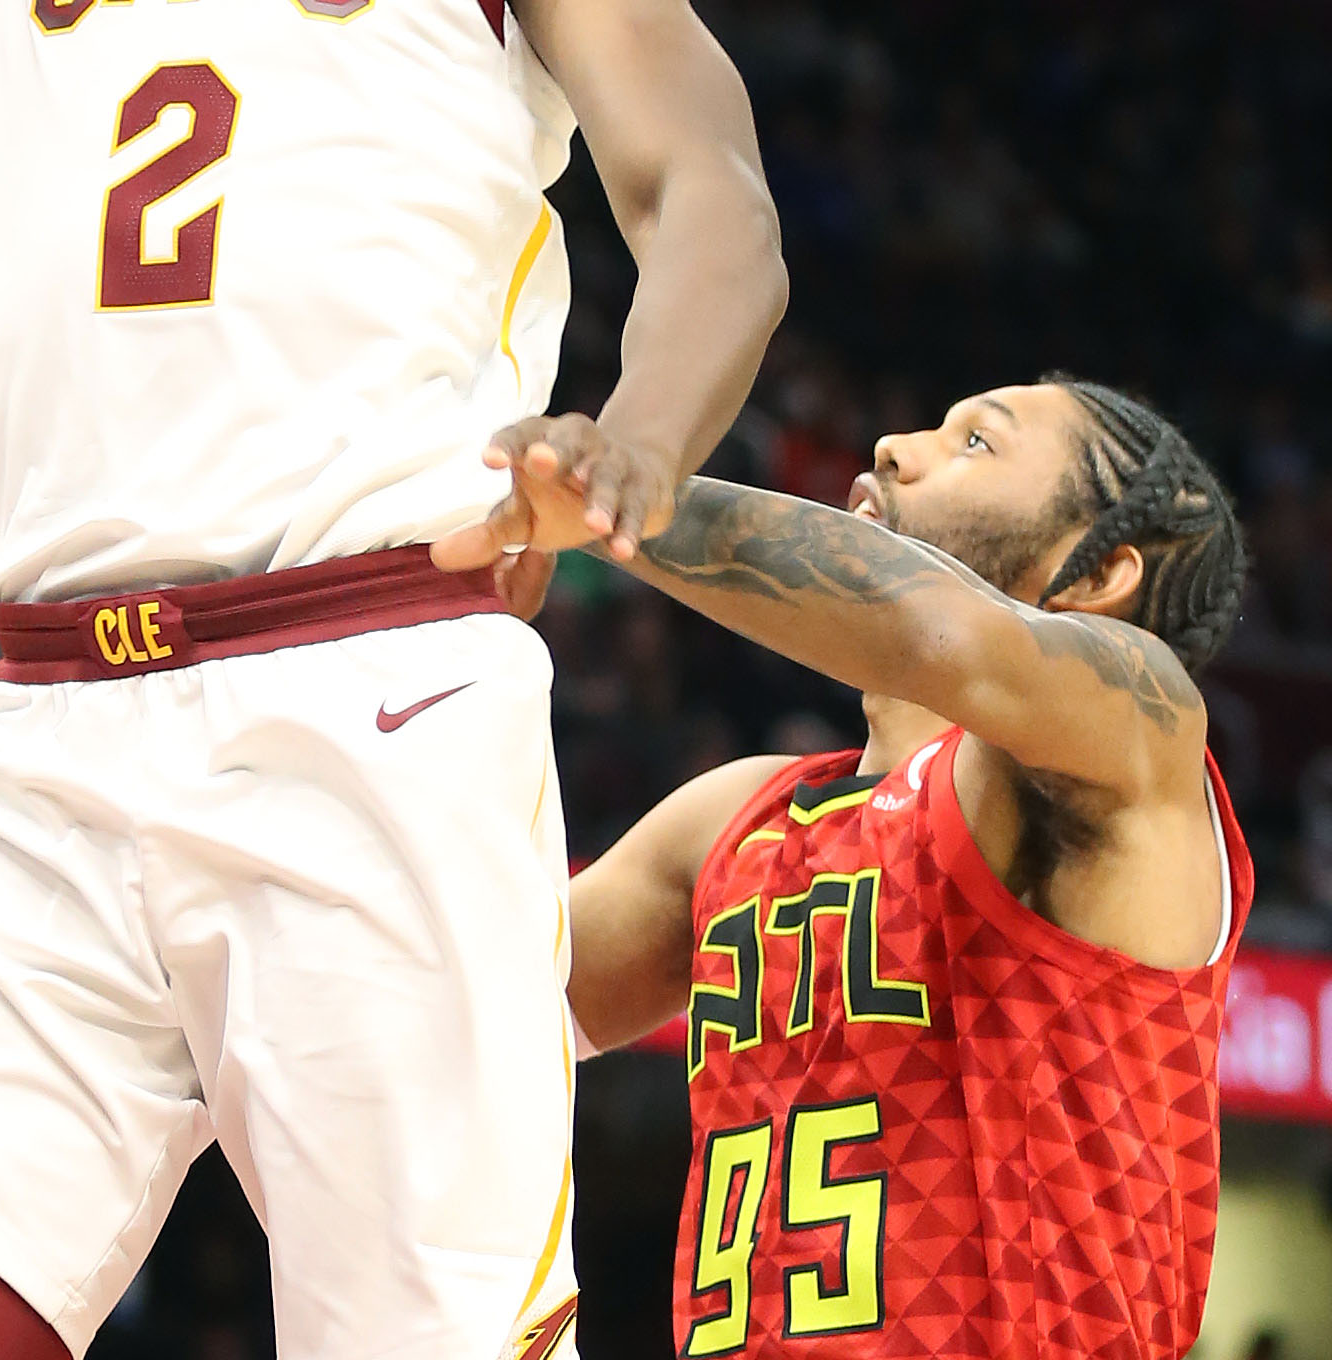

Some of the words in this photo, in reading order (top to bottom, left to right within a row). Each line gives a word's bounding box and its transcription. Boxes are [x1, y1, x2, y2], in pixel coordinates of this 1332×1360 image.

[94, 59, 242, 314] 2
[93, 601, 173, 666] CLE
[687, 866, 931, 1084] ATL
[680, 1093, 887, 1360] 95
